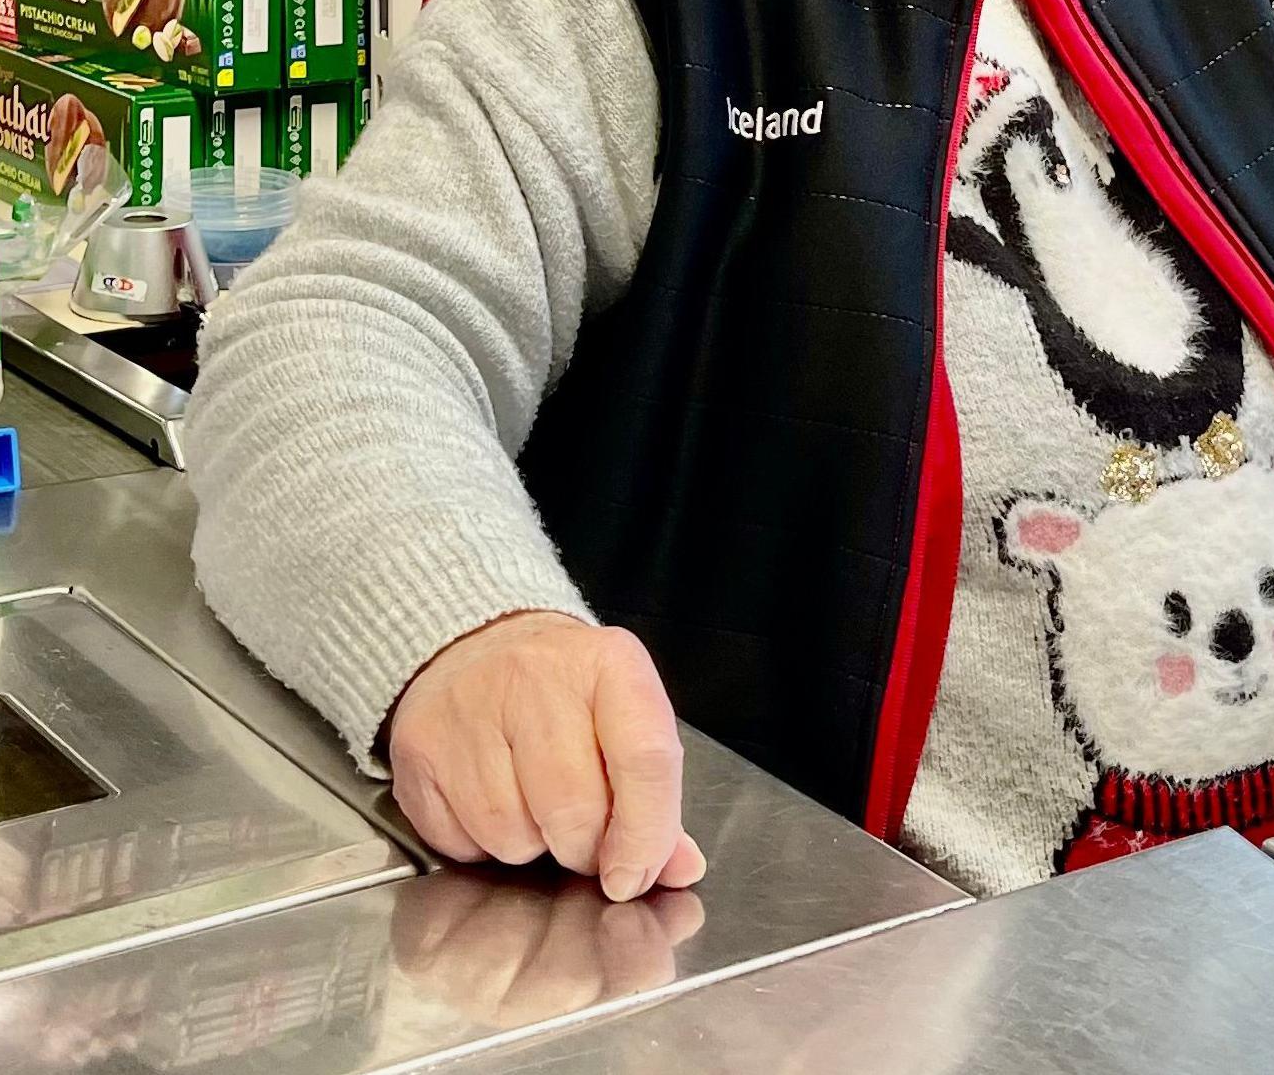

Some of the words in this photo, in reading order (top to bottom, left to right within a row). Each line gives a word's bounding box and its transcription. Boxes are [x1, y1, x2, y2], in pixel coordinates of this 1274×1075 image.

[19, 3, 64, 27] PISTACHIO
[65, 12, 97, 36] CREAM
[726, 96, 824, 141] Iceland
[18, 170, 42, 193] CREAM
